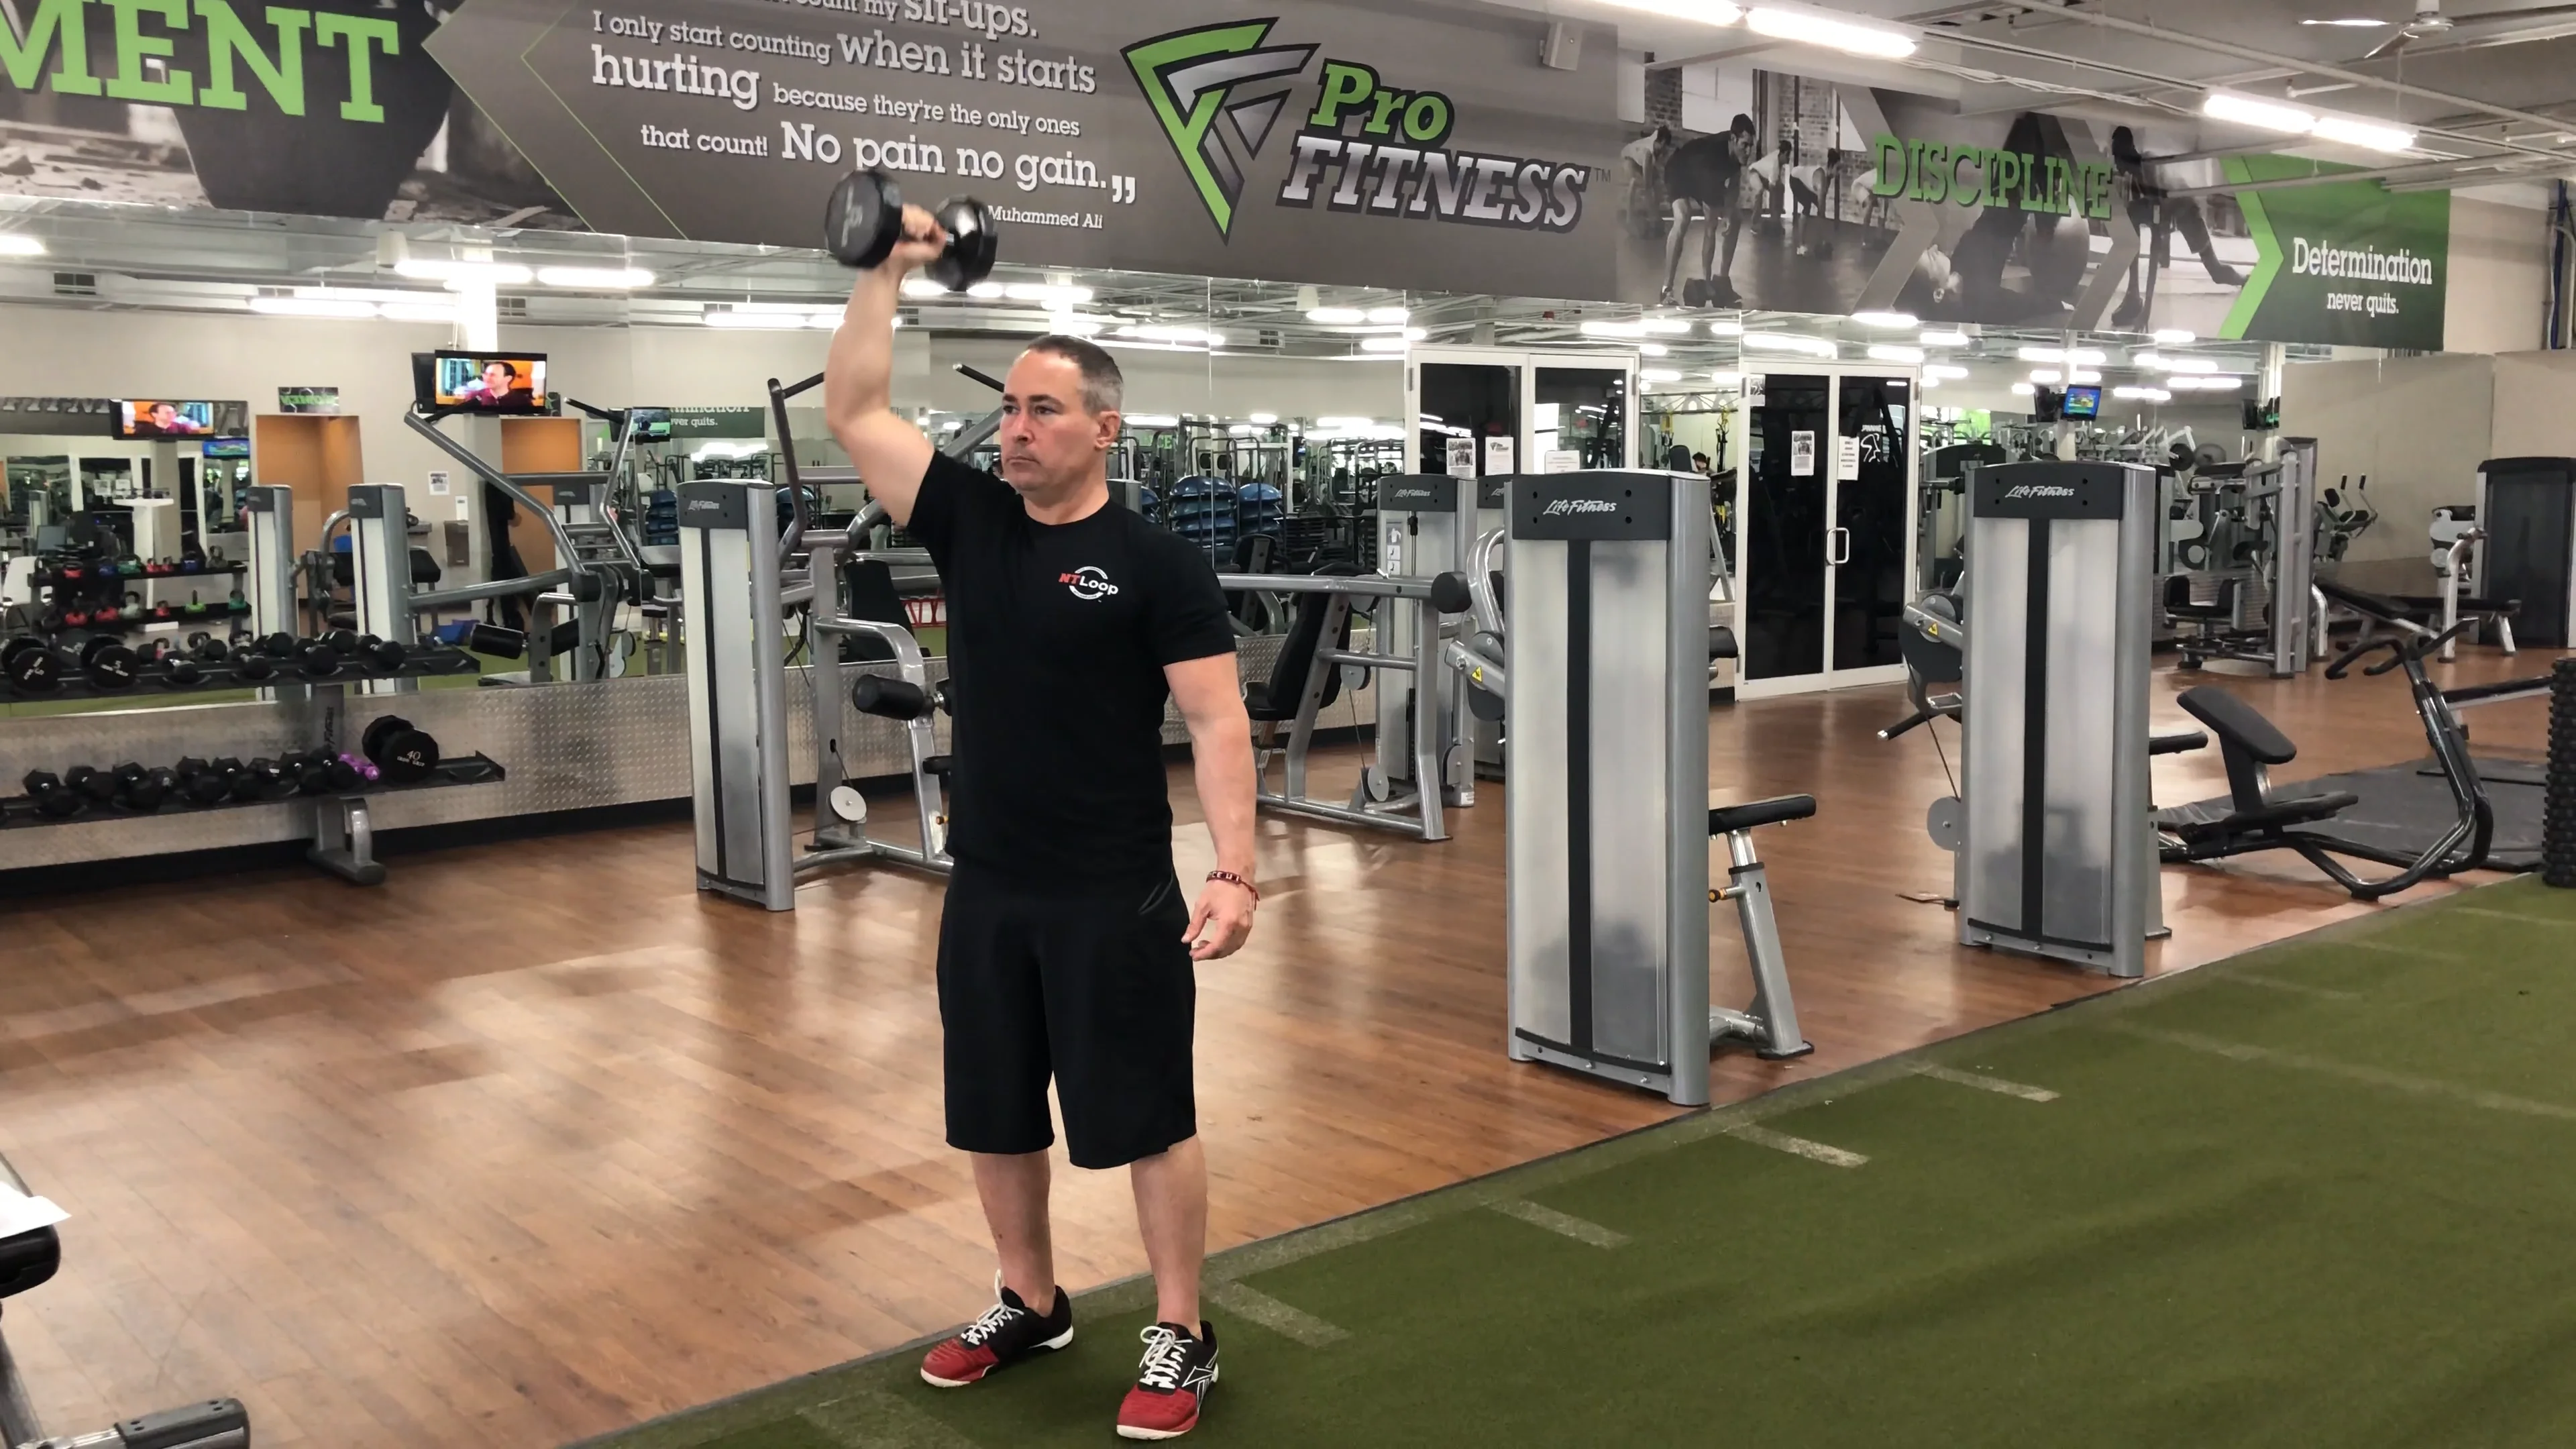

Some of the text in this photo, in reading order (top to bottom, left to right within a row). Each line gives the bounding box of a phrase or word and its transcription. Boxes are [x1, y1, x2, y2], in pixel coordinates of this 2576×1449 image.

[591, 44, 1080, 136] hurting because they're the only ones
[593, 10, 1097, 93] I only start counting when it starts
[1309, 62, 1450, 142] Pro
[641, 125, 690, 150] that
[697, 135, 768, 157] count!
[781, 121, 842, 164] No
[853, 136, 946, 174] pain
[957, 148, 1004, 178] no
[1281, 134, 1587, 228] FITNESS
[1876, 135, 2112, 221] DISCIPLINE
[988, 205, 1102, 229] Muhammed Ali
[2292, 237, 2433, 285] Determination
[2326, 290, 2400, 318] never quits.
